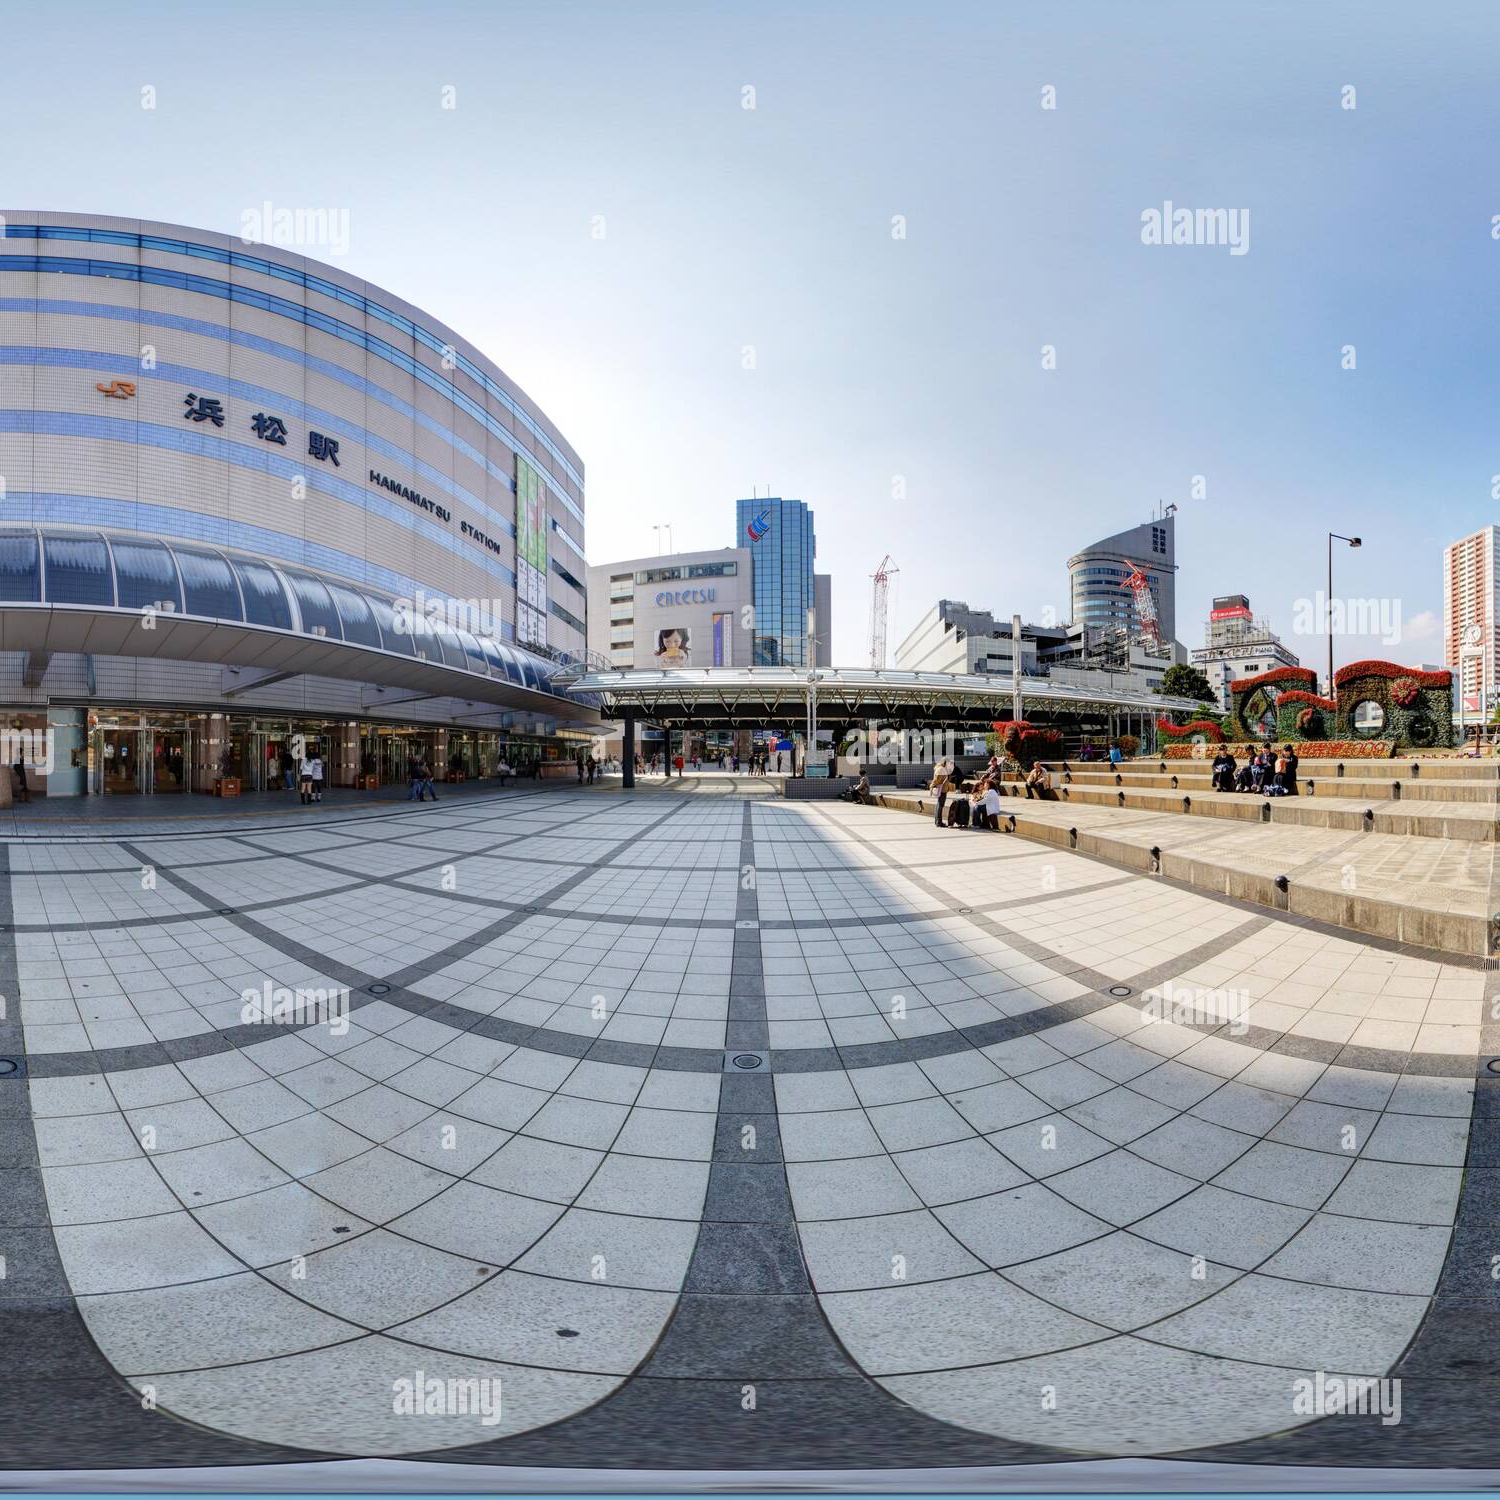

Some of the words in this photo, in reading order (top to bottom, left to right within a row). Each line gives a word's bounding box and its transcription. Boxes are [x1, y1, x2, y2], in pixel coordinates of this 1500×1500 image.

[96, 381, 137, 396] JR
[184, 393, 341, 467] 浜松駅
[370, 470, 451, 523] HAMAMATSU
[460, 521, 501, 555] STATION
